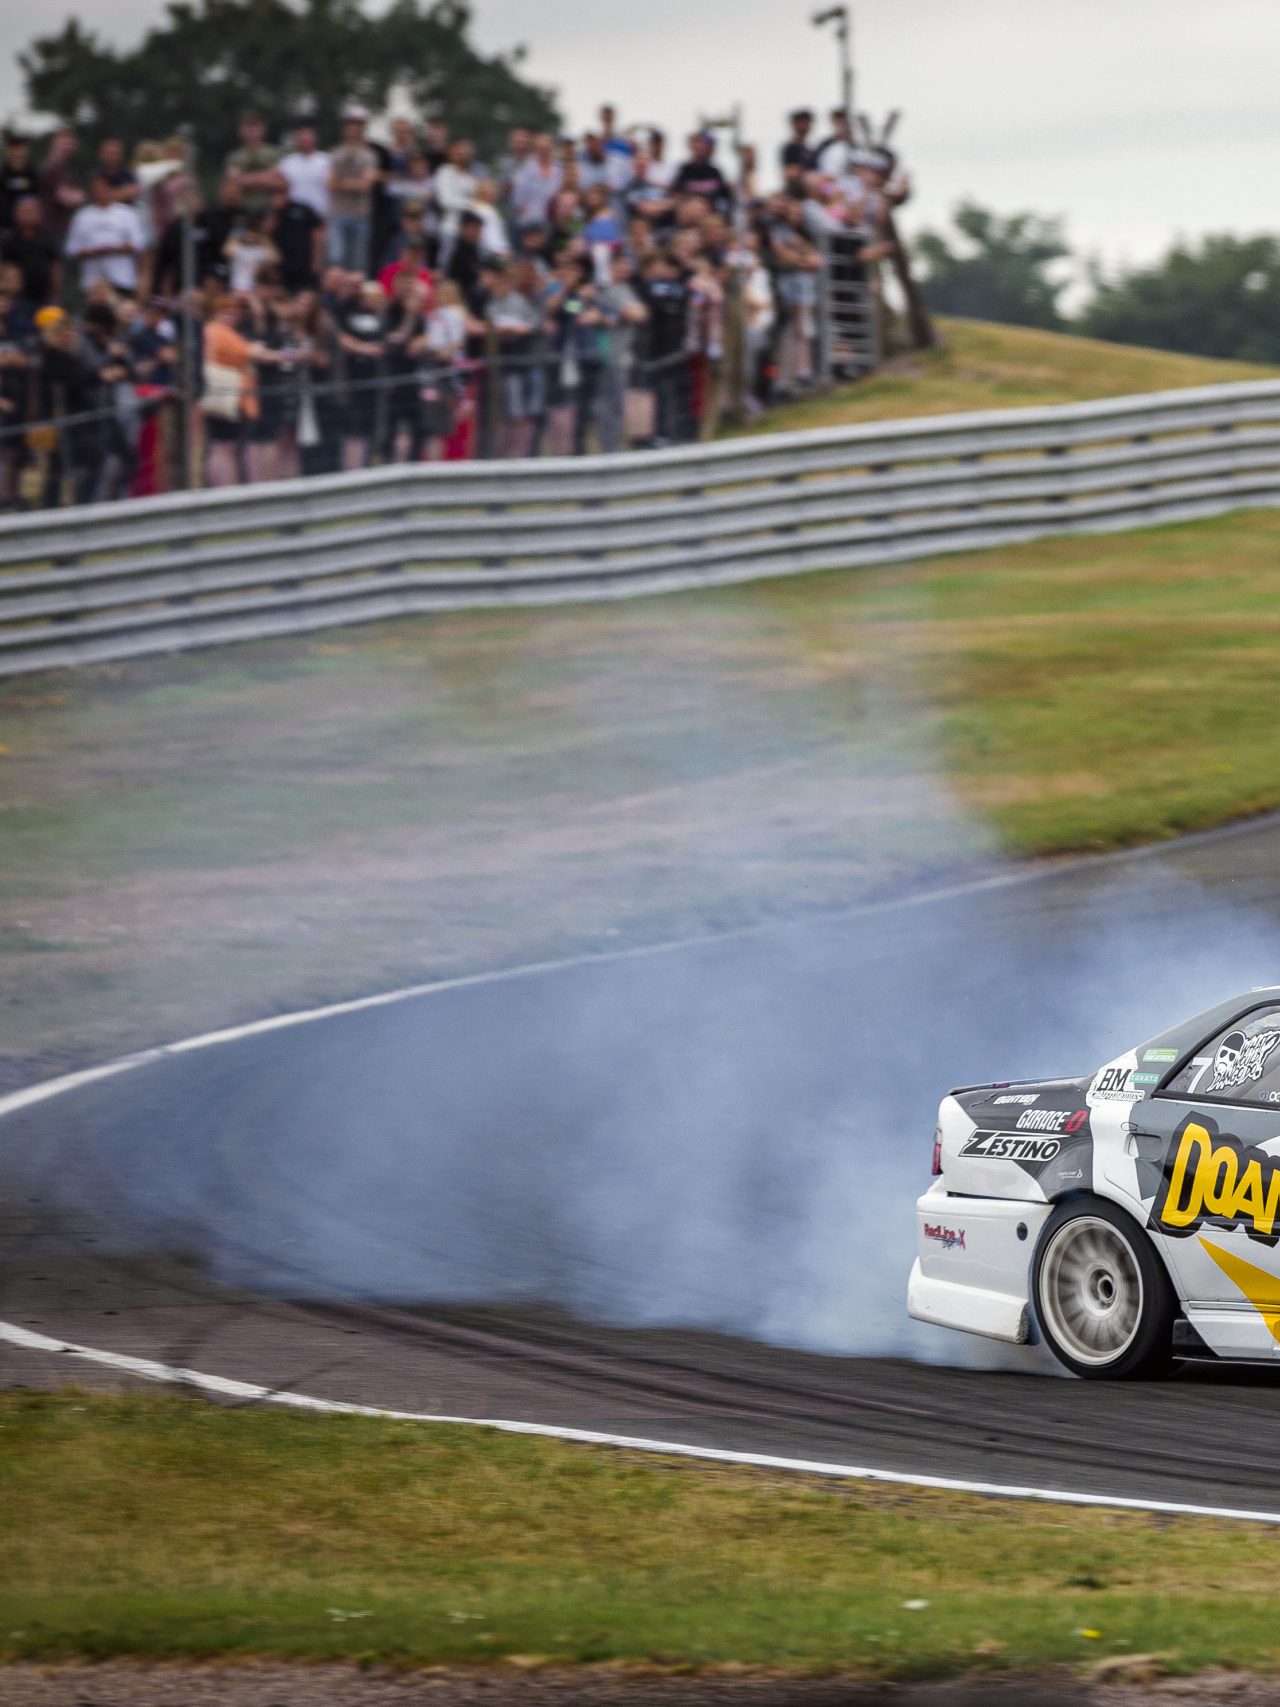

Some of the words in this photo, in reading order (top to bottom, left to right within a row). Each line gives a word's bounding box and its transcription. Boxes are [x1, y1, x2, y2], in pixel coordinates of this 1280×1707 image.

[1096, 1068, 1132, 1092] BM
[1187, 1056, 1214, 1093] 7
[961, 1130, 1062, 1160] ZESTINO
